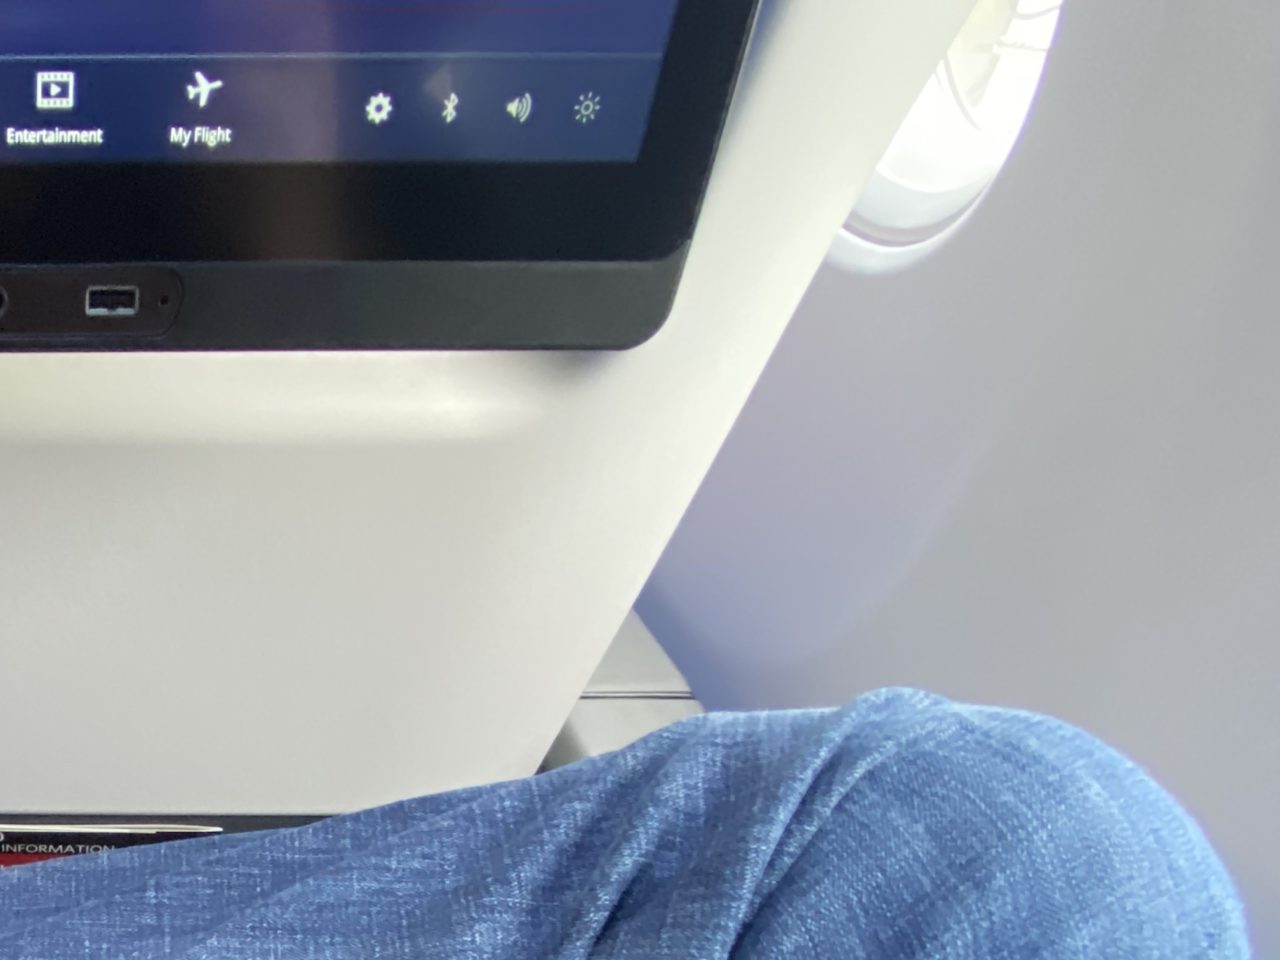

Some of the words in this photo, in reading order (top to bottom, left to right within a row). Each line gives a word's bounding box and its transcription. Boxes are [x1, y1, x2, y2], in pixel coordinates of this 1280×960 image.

[5, 126, 104, 146] Entertainment
[169, 126, 192, 147] My
[193, 125, 233, 148] Flight
[1, 843, 116, 854] INFORMATION
